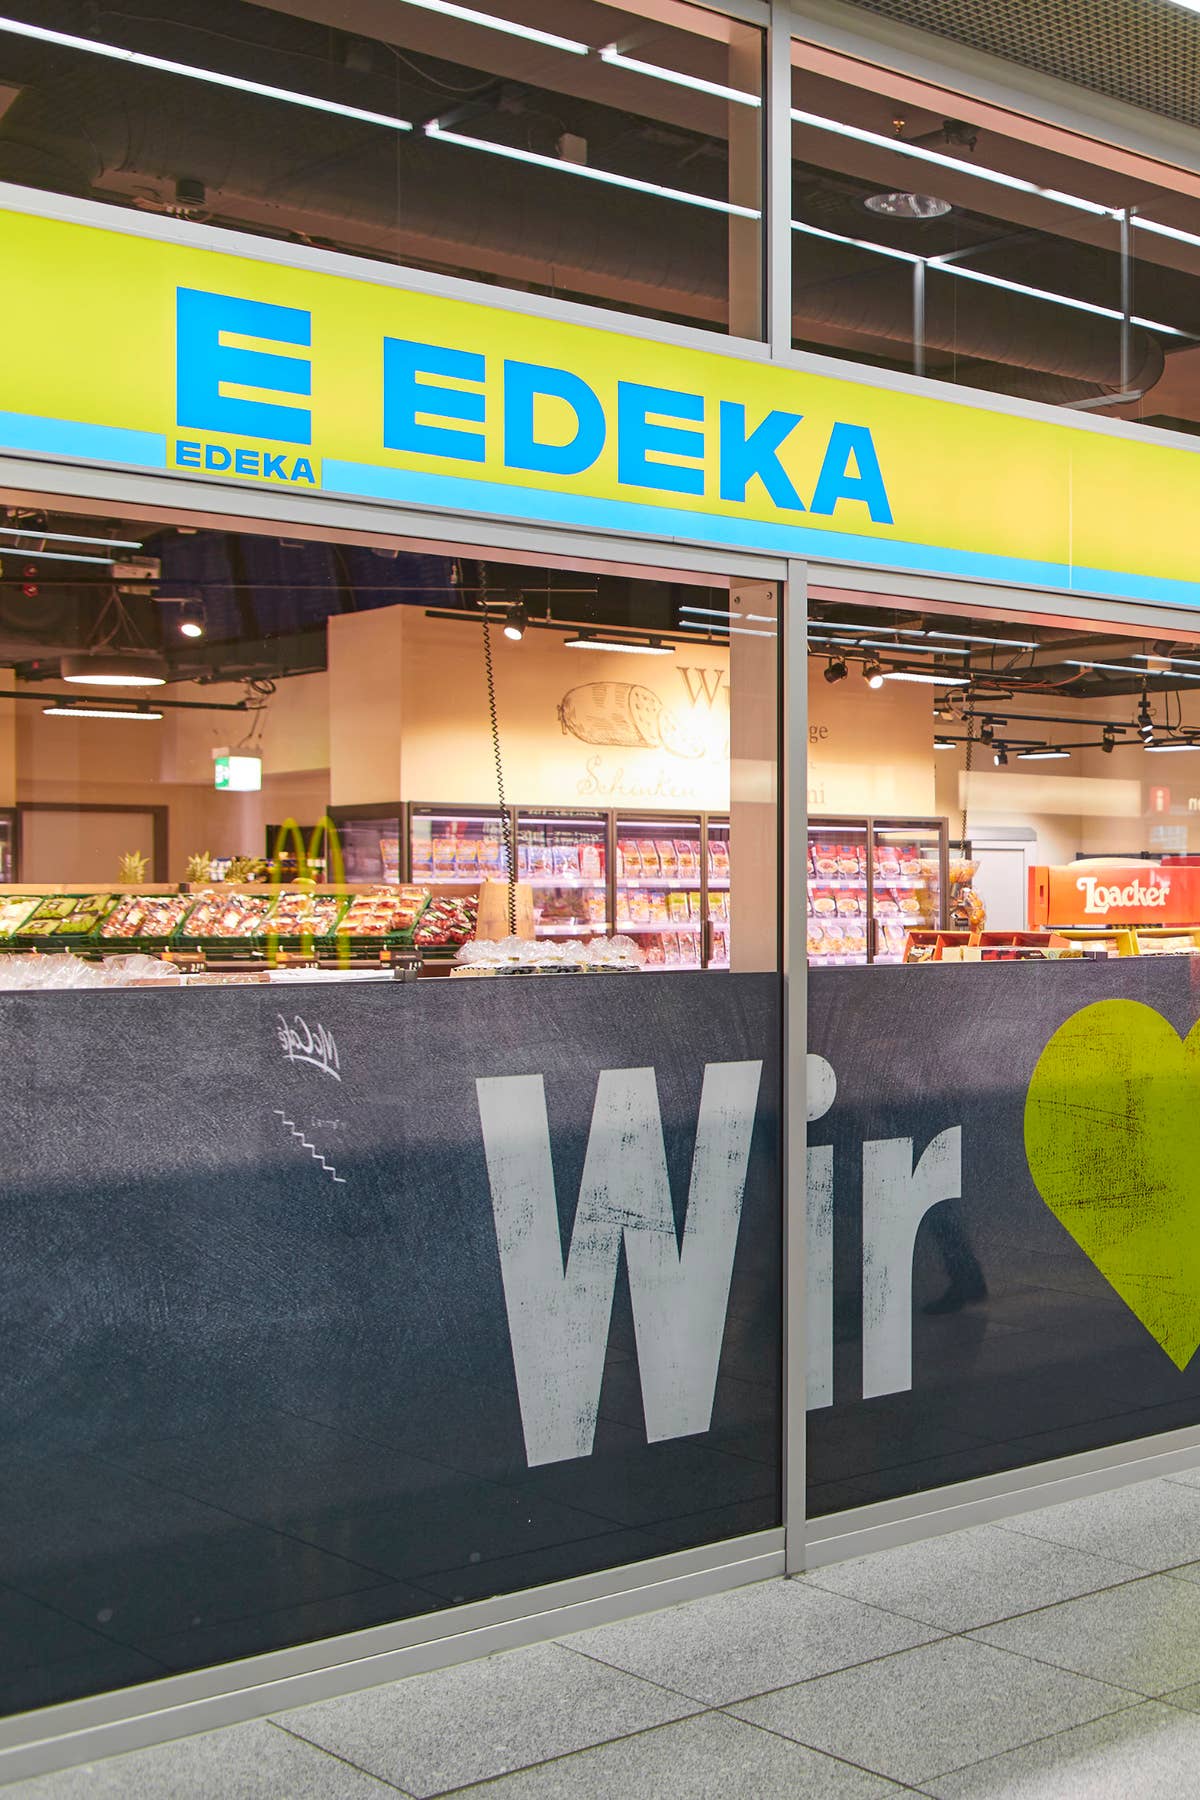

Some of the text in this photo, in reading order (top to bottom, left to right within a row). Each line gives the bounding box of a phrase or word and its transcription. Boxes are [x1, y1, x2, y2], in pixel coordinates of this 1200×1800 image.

[176, 287, 894, 524] E EDEKA
[176, 441, 316, 484] EDEKA
[1076, 877, 1170, 914] Loacker
[475, 1053, 962, 1467] Wir
